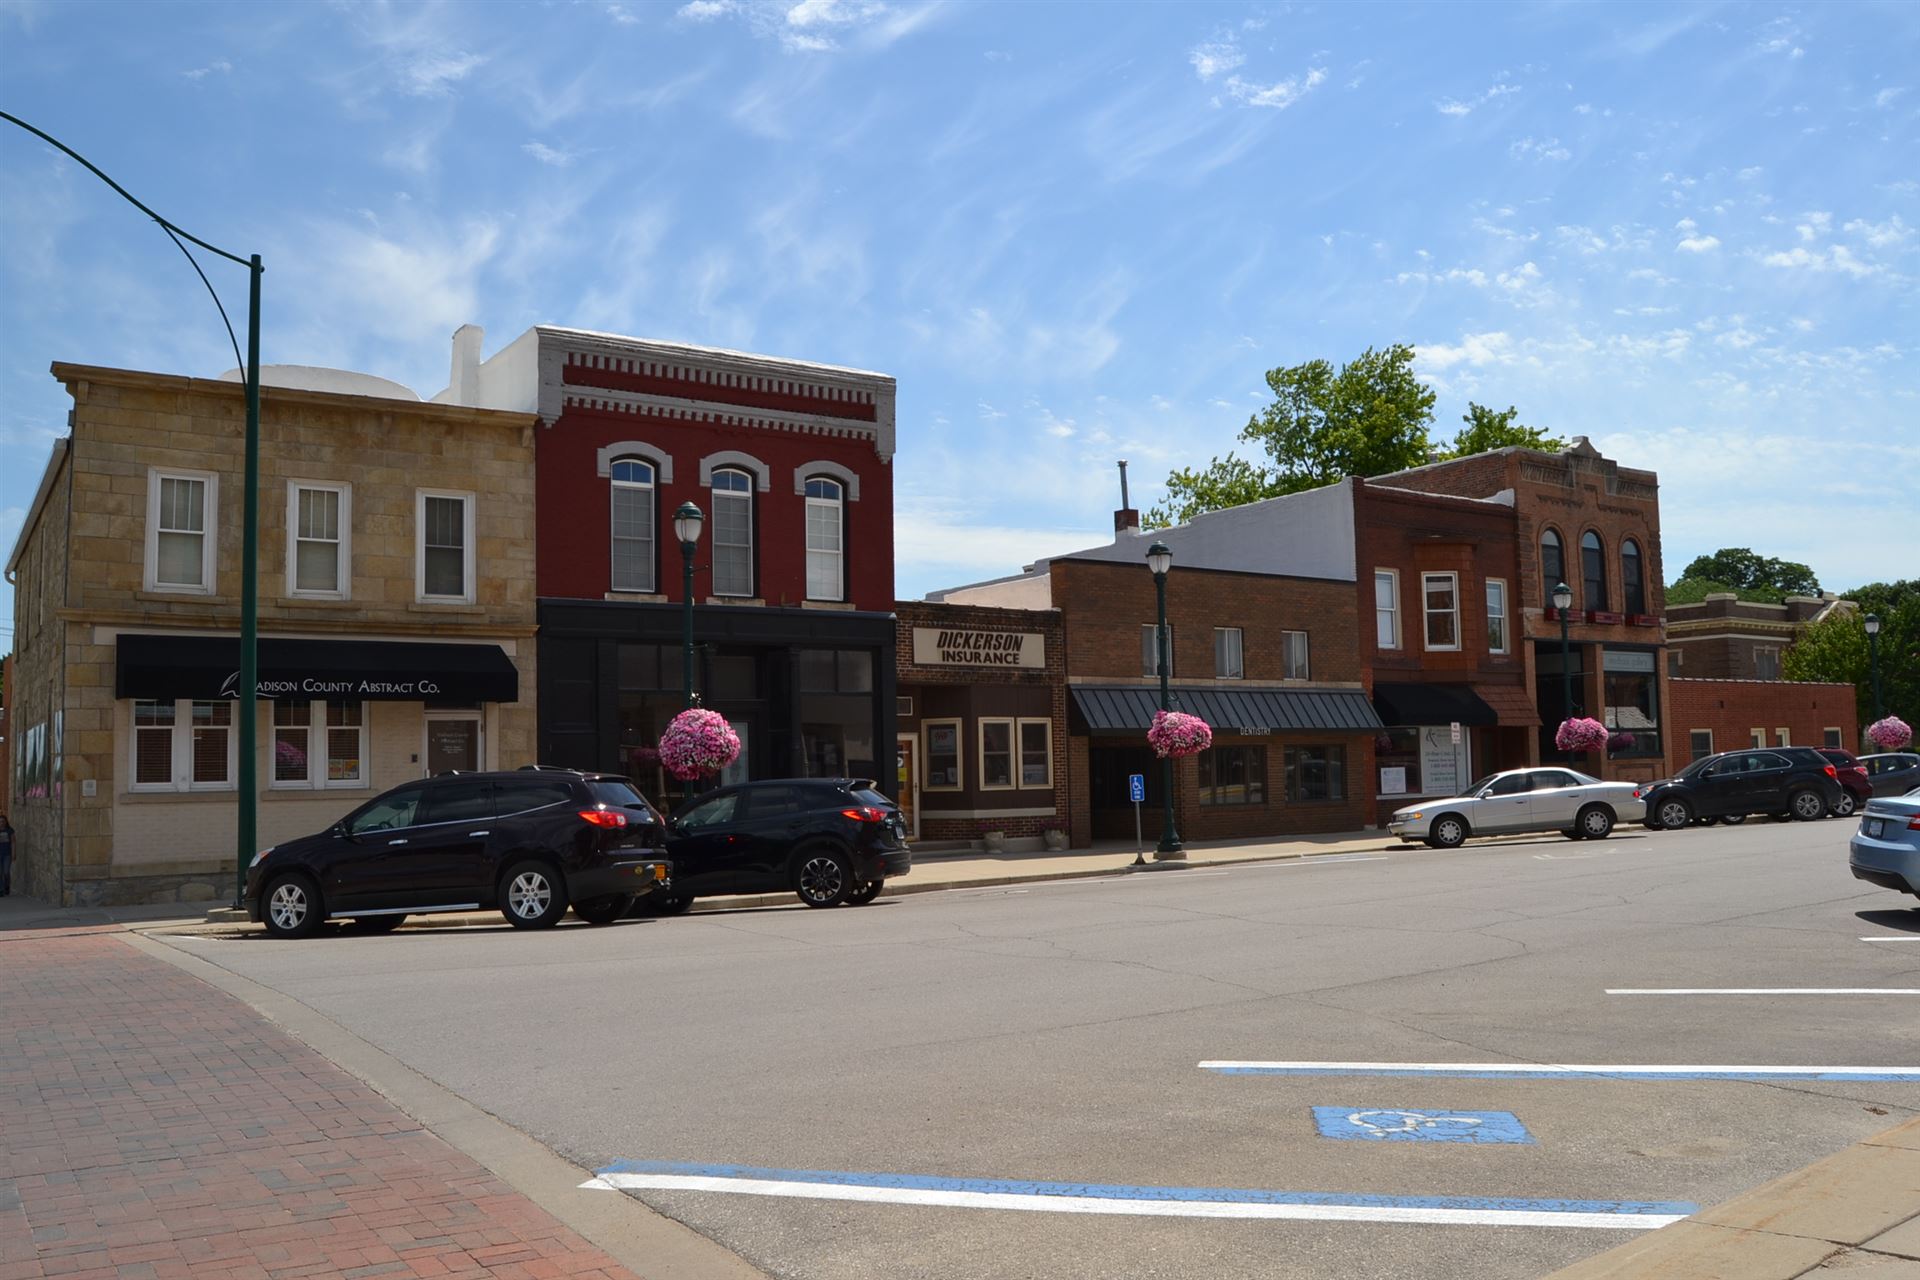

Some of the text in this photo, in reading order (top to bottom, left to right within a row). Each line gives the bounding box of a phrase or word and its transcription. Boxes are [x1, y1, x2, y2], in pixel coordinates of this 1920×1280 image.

[936, 631, 1024, 652] DICKERSON
[942, 651, 1020, 665] INSURANCE
[255, 681, 298, 692] ADISON
[1240, 727, 1271, 736] DENTISTRY
